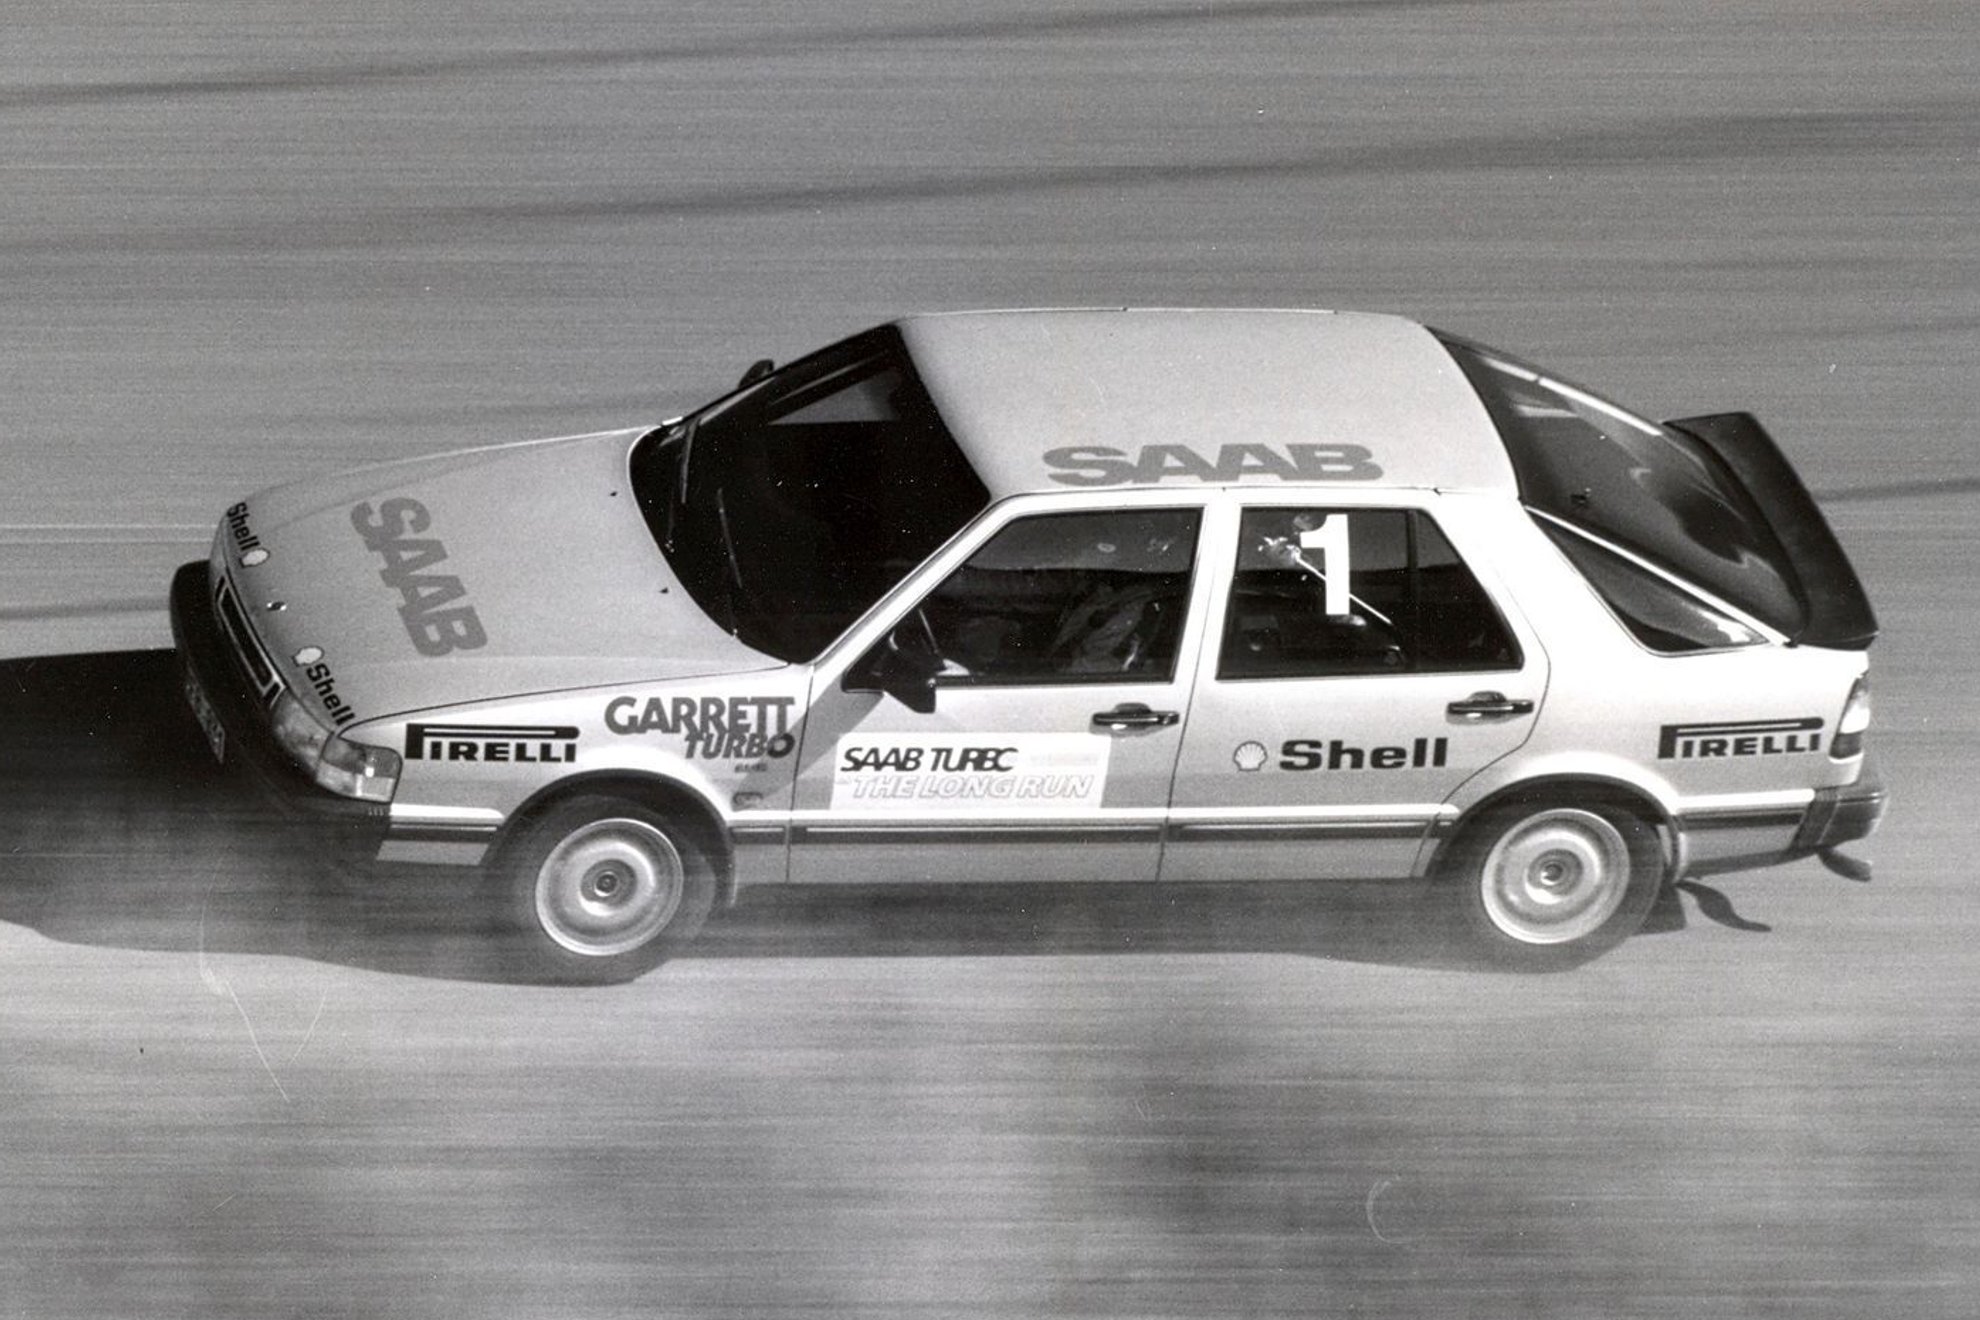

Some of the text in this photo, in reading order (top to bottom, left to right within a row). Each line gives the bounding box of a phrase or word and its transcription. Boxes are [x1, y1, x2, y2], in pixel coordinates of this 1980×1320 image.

[1042, 443, 1383, 486] SAAB
[227, 502, 261, 550] Shell
[350, 497, 488, 657] SAAB
[1300, 514, 1349, 615] 1
[306, 663, 354, 725] Shell
[605, 696, 795, 735] GARRETT
[404, 723, 580, 762] PIRELLI
[684, 732, 795, 759] TURBO
[1279, 737, 1448, 771] Shell
[1658, 717, 1824, 759] PIRELLI
[840, 747, 924, 772] SAAB
[852, 775, 1095, 798] THE LONG RUN
